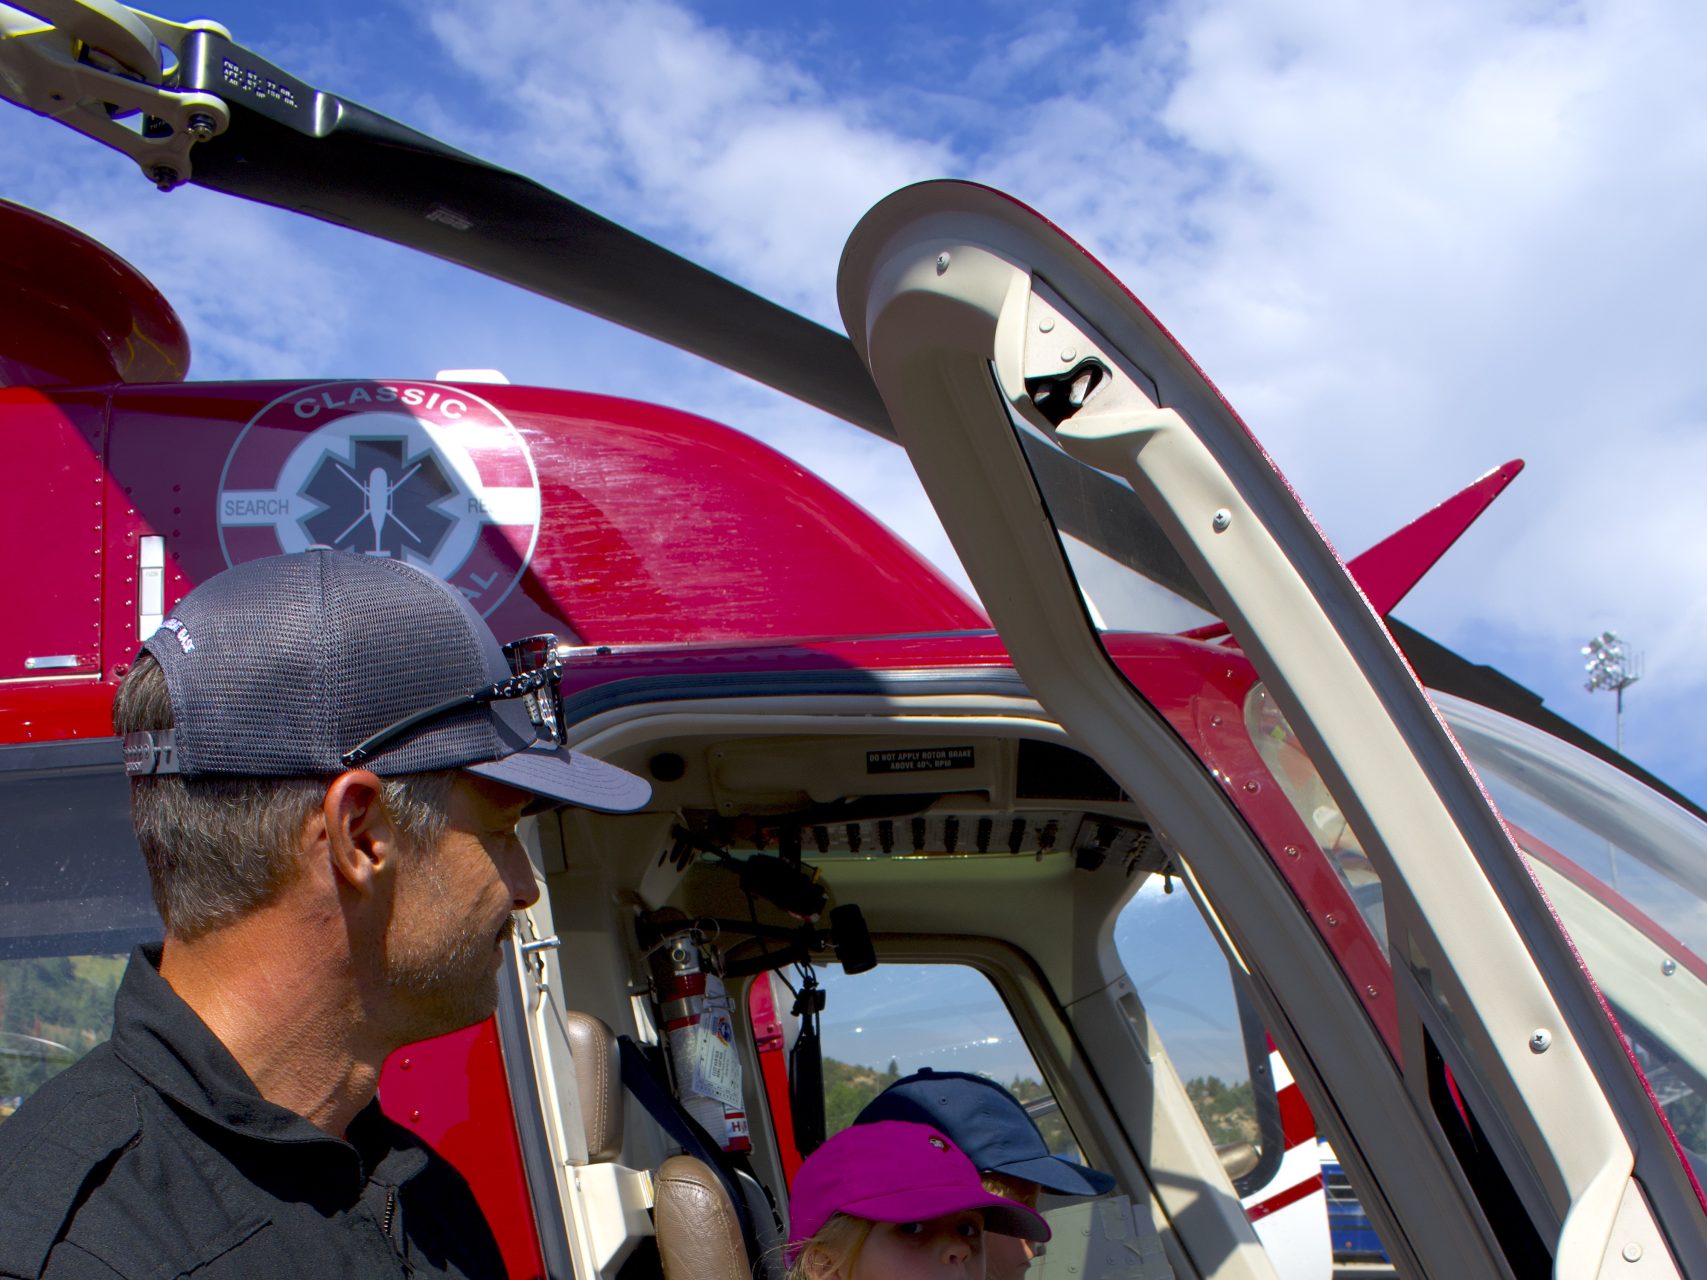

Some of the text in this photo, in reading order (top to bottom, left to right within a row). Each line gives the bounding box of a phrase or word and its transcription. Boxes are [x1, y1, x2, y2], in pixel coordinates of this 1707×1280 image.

[294, 385, 467, 419] CLASSIC
[224, 498, 289, 516] SEARCH
[869, 749, 972, 762] DO NOT APPLY ROTOR BRAKE
[890, 760, 914, 770] ABOVE
[934, 759, 952, 768] RPM
